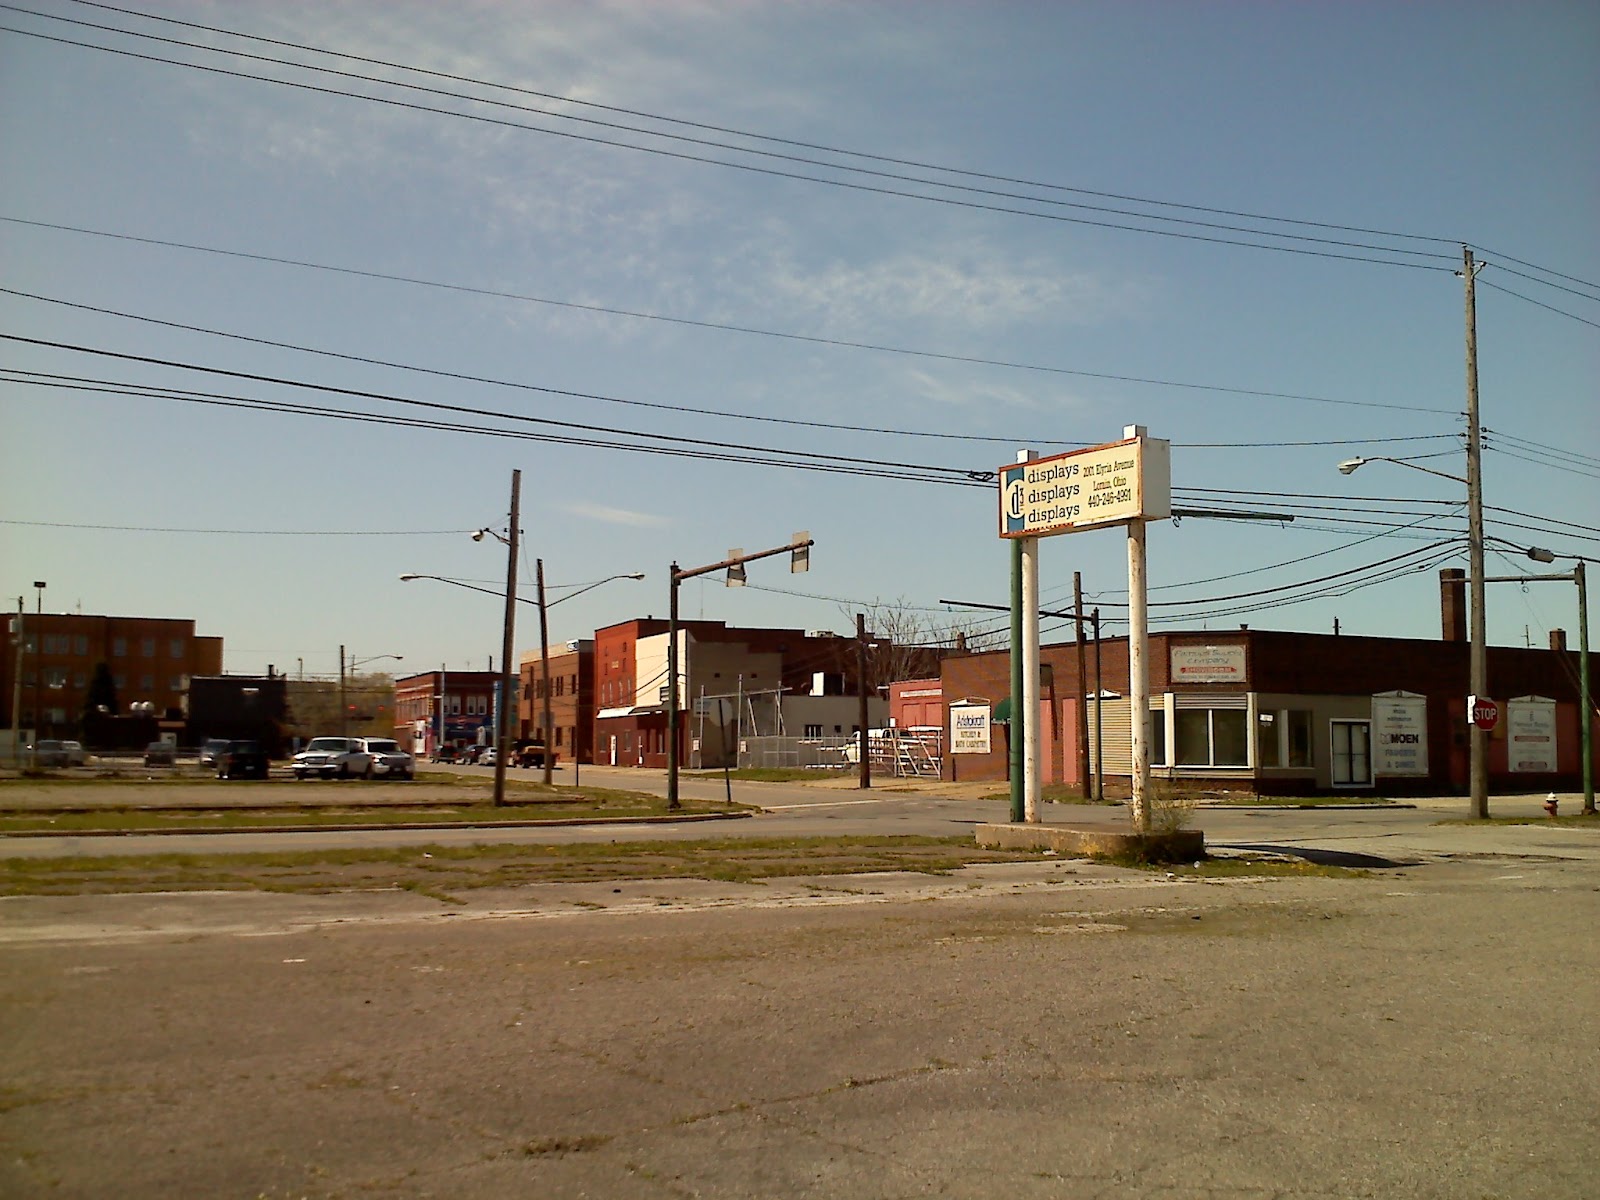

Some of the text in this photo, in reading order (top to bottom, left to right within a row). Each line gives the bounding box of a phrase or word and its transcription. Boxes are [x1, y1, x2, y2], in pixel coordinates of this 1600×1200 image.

[1028, 464, 1079, 484] displays
[1096, 463, 1112, 476] Elyria
[1113, 459, 1134, 471] Avenue
[1113, 476, 1126, 487] Ohio
[1028, 484, 1080, 503] displays
[1028, 504, 1080, 523] displays
[1474, 708, 1497, 720] STOP
[1391, 733, 1419, 744] MOEN
